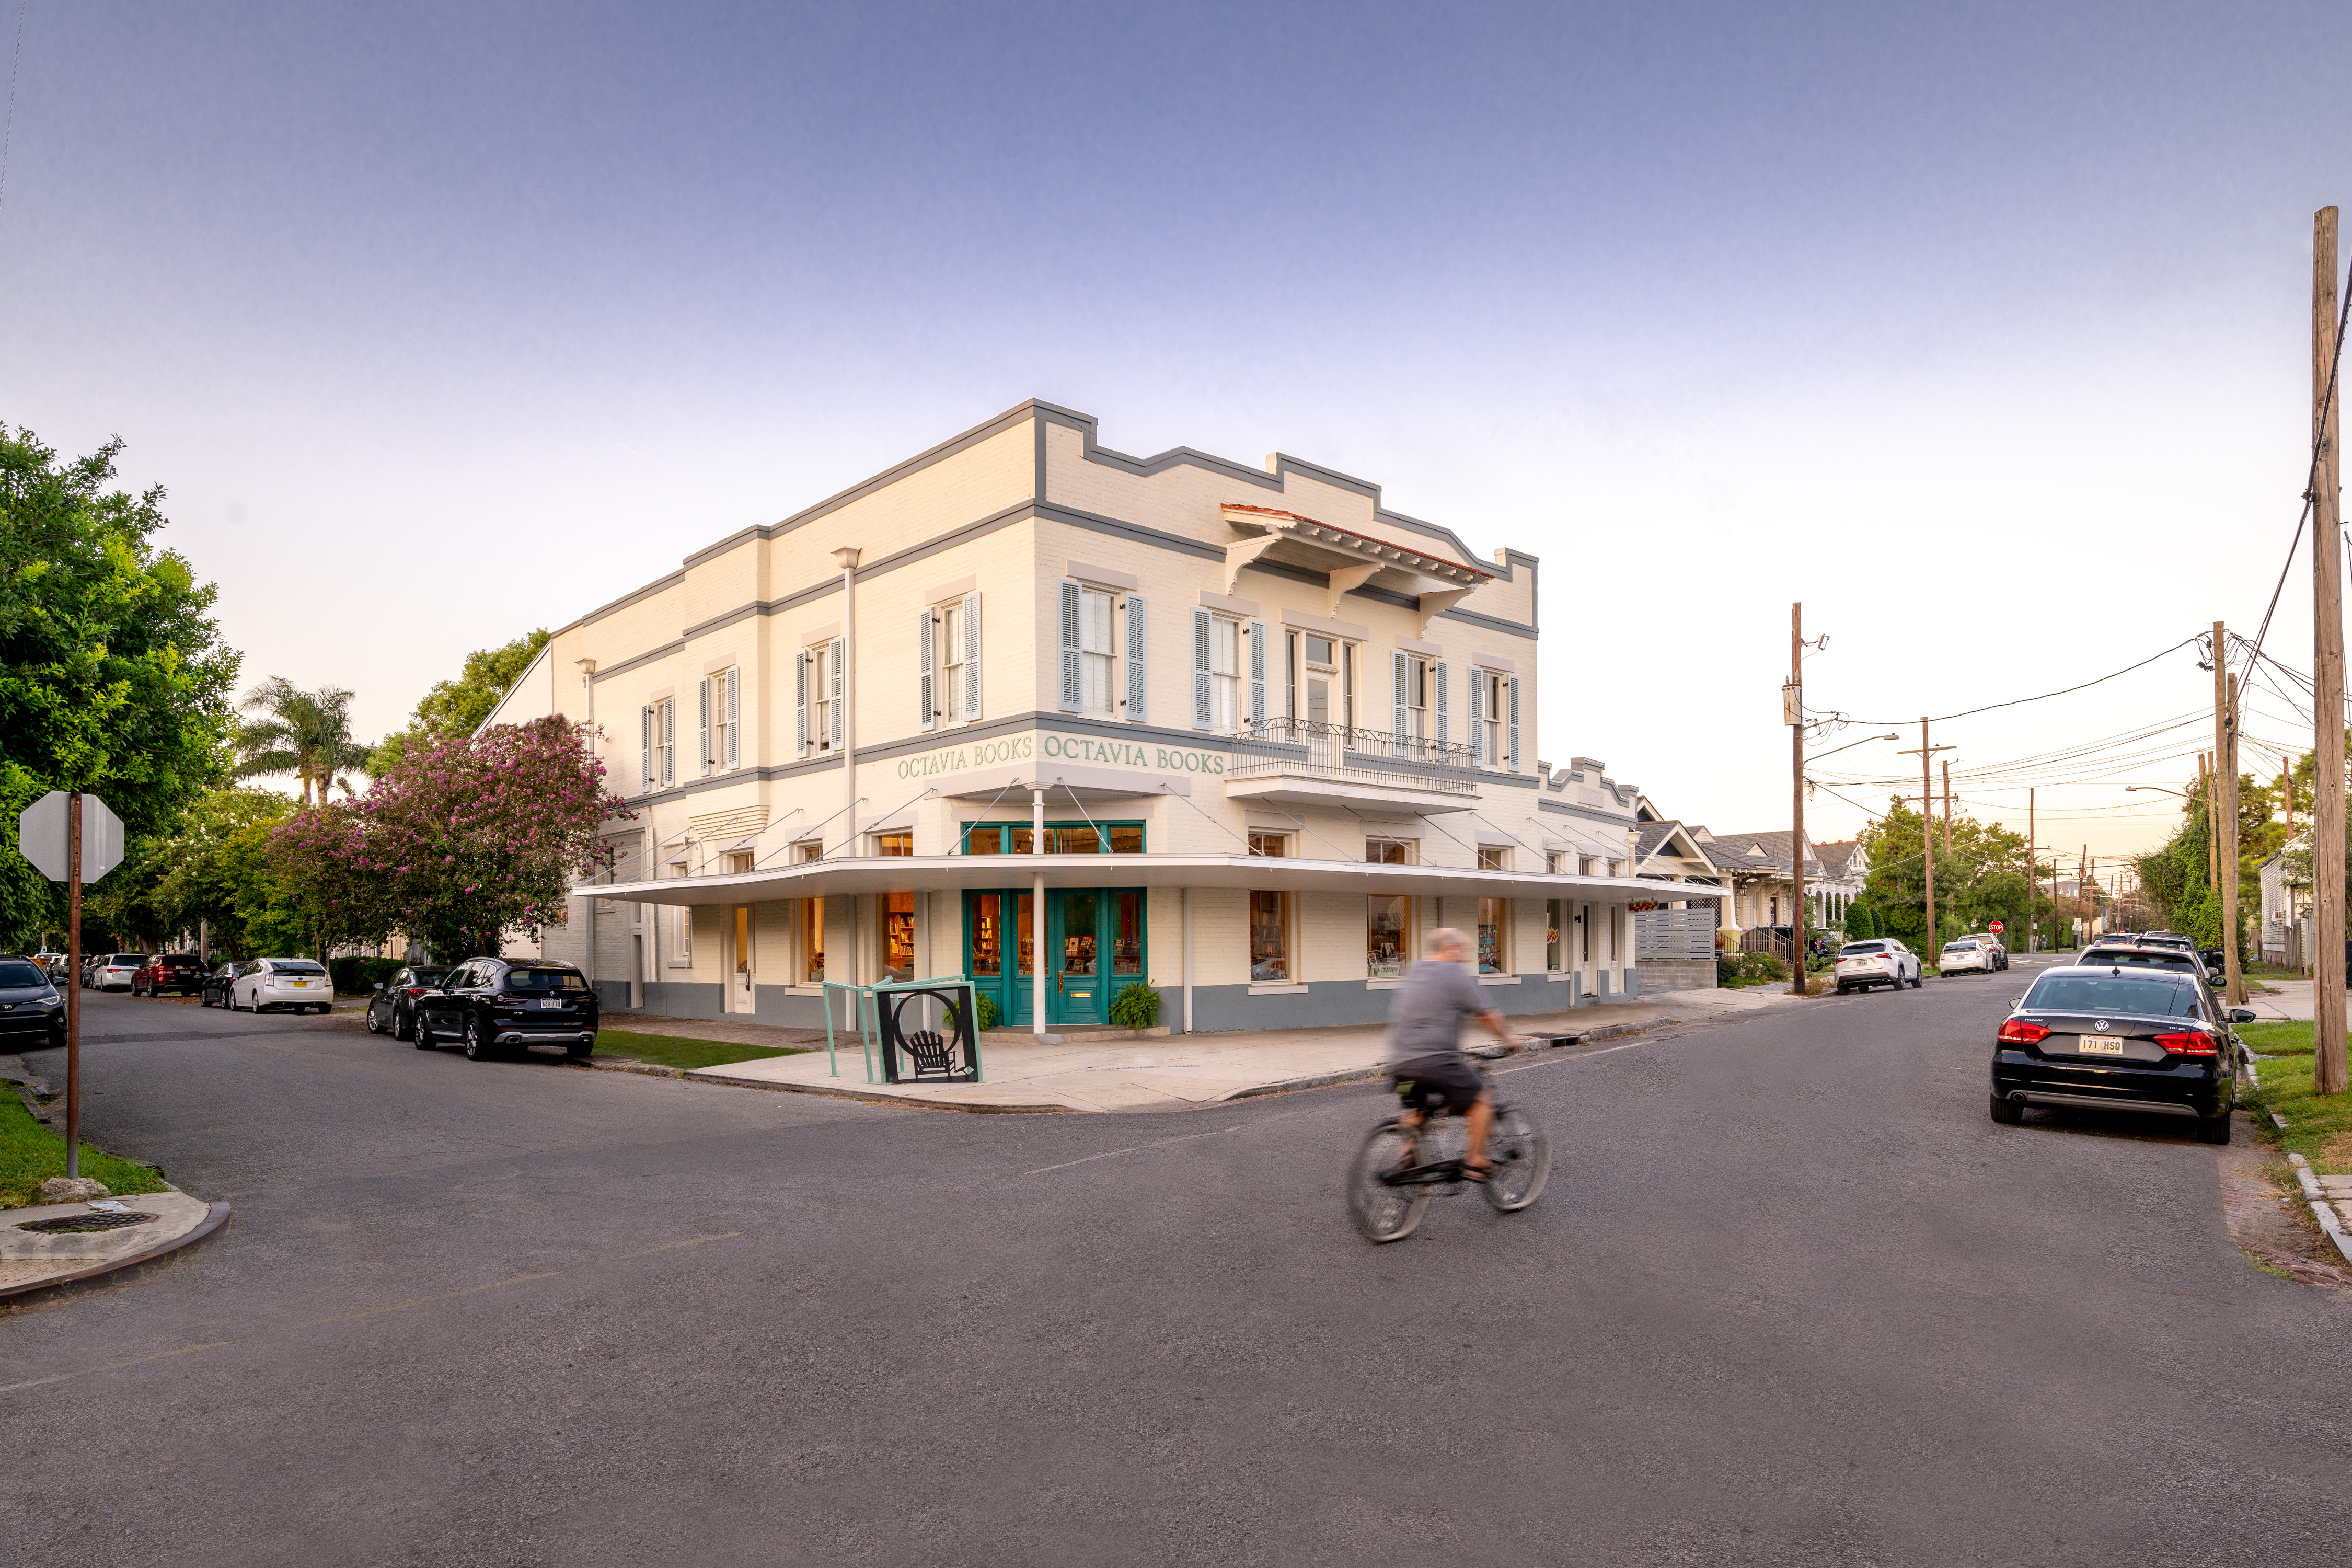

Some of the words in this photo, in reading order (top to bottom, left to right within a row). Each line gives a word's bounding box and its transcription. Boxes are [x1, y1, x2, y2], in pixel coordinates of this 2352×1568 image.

[898, 749, 967, 779] OCTAVIA
[974, 736, 1032, 766] BOOKS
[1045, 735, 1148, 766] OCTAVIA
[1156, 748, 1224, 774] BOOKS
[2083, 1040, 2097, 1049] 171
[2104, 1041, 2120, 1051] HSQ
